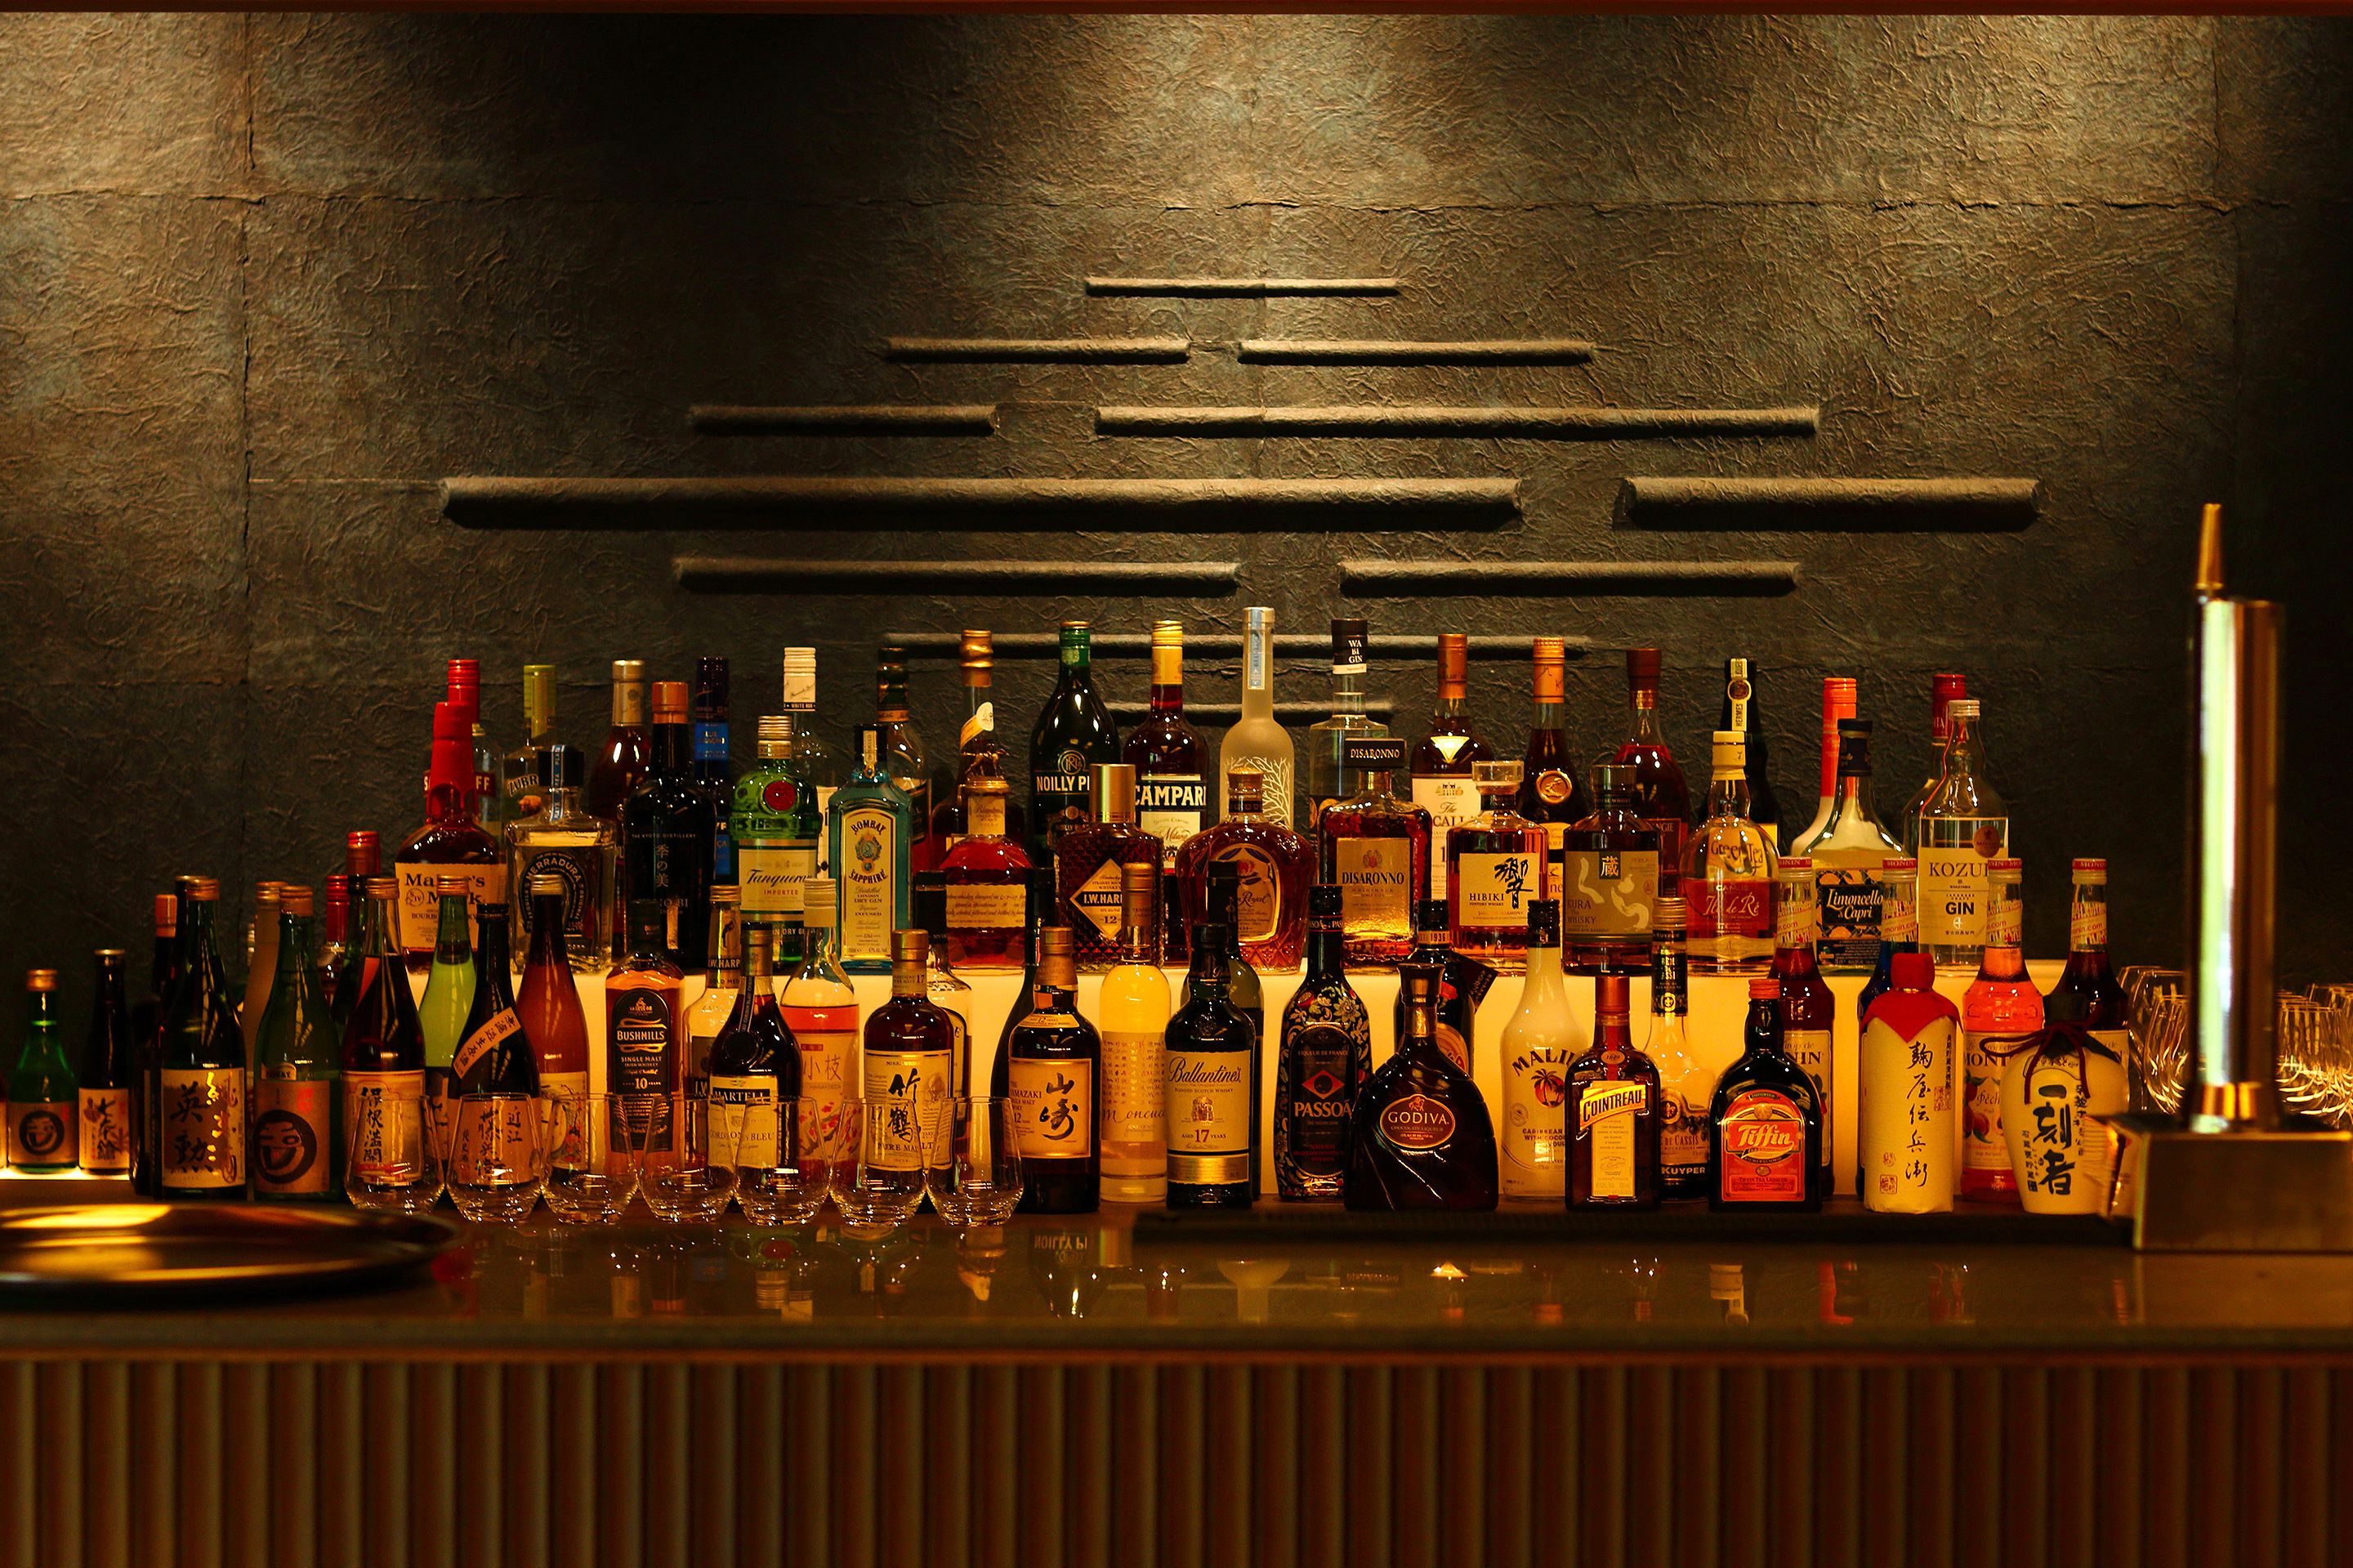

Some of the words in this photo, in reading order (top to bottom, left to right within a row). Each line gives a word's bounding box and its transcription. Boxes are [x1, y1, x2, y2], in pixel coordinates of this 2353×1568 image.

[1348, 640, 1362, 648] WA
[1348, 655, 1363, 663] GIN
[1350, 748, 1400, 759] DISARONNO
[507, 774, 539, 797] ZUBR
[1036, 775, 1075, 792] NOILLY
[1135, 785, 1206, 806] CAMPARI
[1437, 802, 1458, 814] The
[851, 819, 886, 836] BOMBAY
[526, 856, 582, 881] HERRADURA
[656, 844, 669, 887] 季の美
[1601, 855, 1619, 877] 蔵
[1929, 862, 1988, 877] KOZU
[405, 872, 485, 888] Ma's
[848, 869, 888, 884] SAPPHIRE
[1342, 872, 1404, 885] DISARONNO
[427, 891, 484, 905] Mk
[1083, 894, 1123, 904] I.W.HAR
[1469, 893, 1504, 901] HIBIKI
[1826, 888, 1883, 911] Limoncello
[1567, 900, 1592, 909] KURA
[1945, 901, 1975, 915] GIN
[1104, 915, 1118, 924] 12
[1567, 916, 1596, 924] WHISKY
[1844, 905, 1873, 922] Capri
[782, 927, 797, 936] DRY
[1884, 922, 1917, 933] monin.co
[1430, 932, 1446, 942] 1936
[916, 975, 925, 983] 17
[616, 1030, 665, 1041] BUSHMILLS
[1790, 1052, 1821, 1065] NIN
[1962, 1052, 2008, 1067] MONI
[1168, 1056, 1242, 1083] Ballantine's
[634, 1078, 648, 1090] 10
[887, 1067, 921, 1144] 竹鶴
[1976, 1091, 2001, 1106] Pêch
[1039, 1072, 1078, 1141] 山崎
[1583, 1089, 1642, 1123] COINTREAU
[1388, 1111, 1447, 1125] GODIVA
[1194, 1128, 1210, 1142] 17
[1675, 1135, 1699, 1145] CASSIS
[1738, 1124, 1793, 1148] Tiffin
[1661, 1166, 1706, 1174] KUYPER
